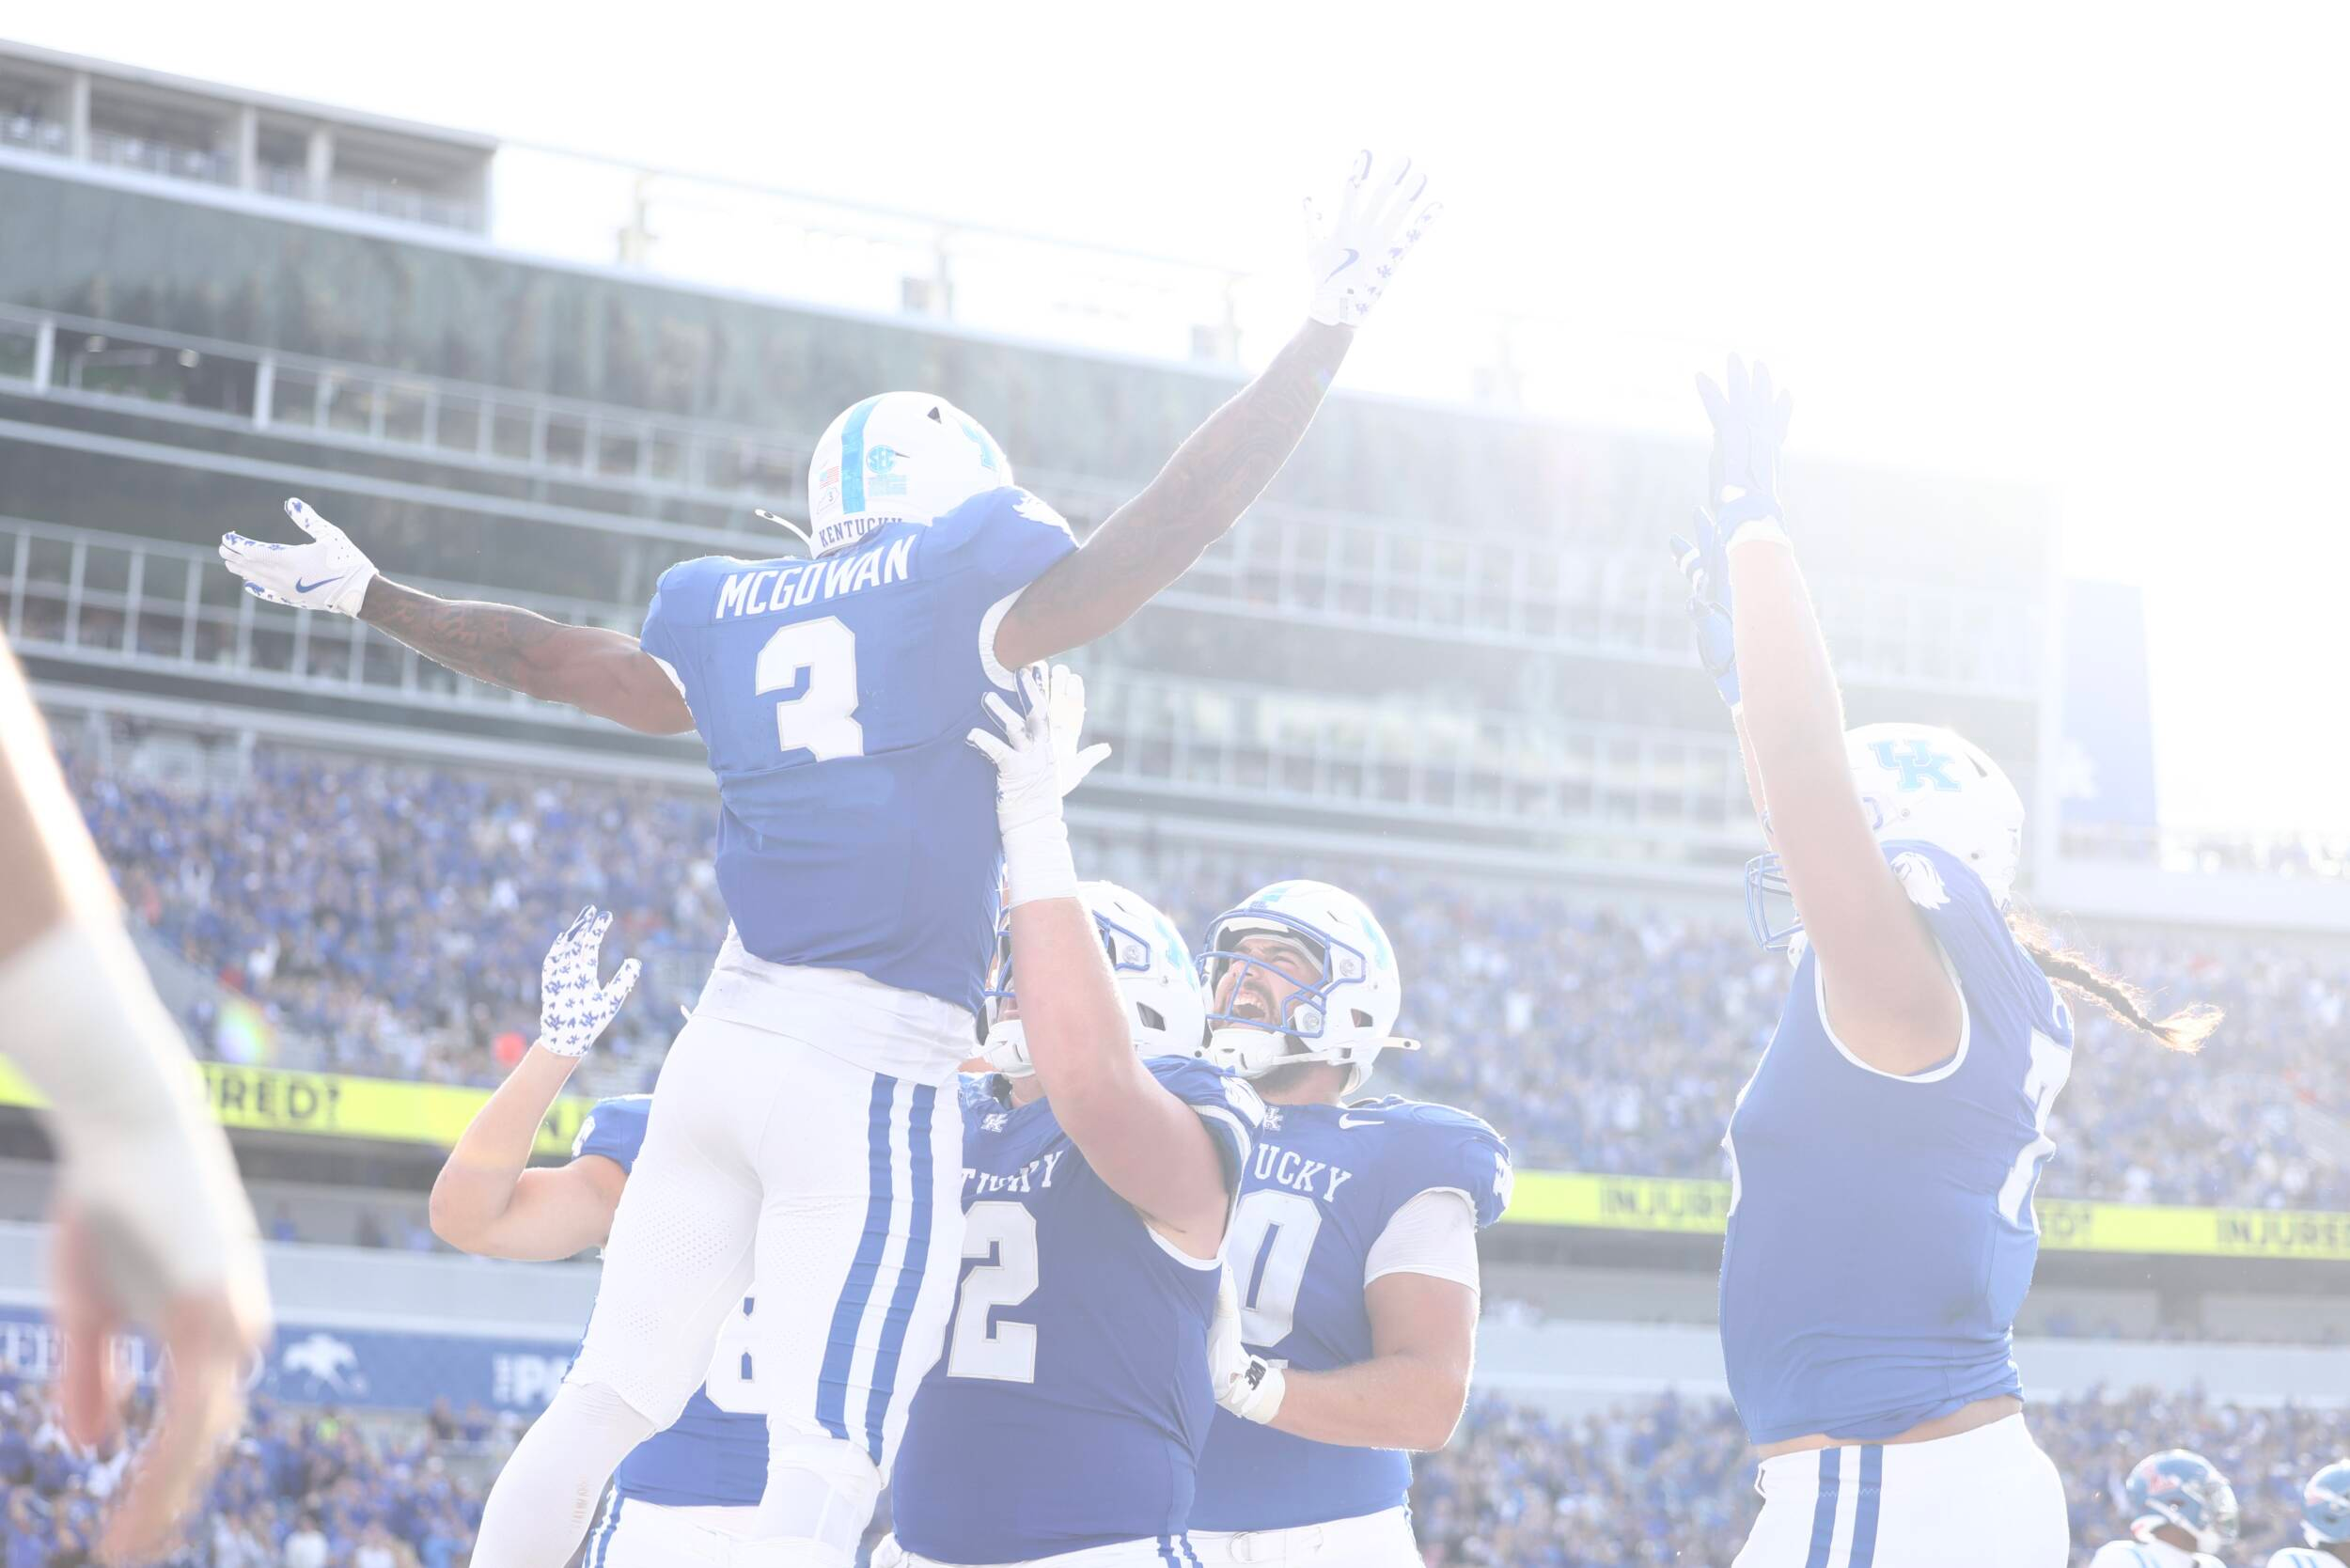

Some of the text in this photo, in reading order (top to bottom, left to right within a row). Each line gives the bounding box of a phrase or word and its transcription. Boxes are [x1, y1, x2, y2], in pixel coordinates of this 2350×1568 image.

[715, 534, 916, 619] MCGOWAN
[755, 616, 865, 763] 3
[1868, 738, 1962, 792] UK
[947, 1200, 1040, 1385] 2
[1228, 1187, 1324, 1349] 0
